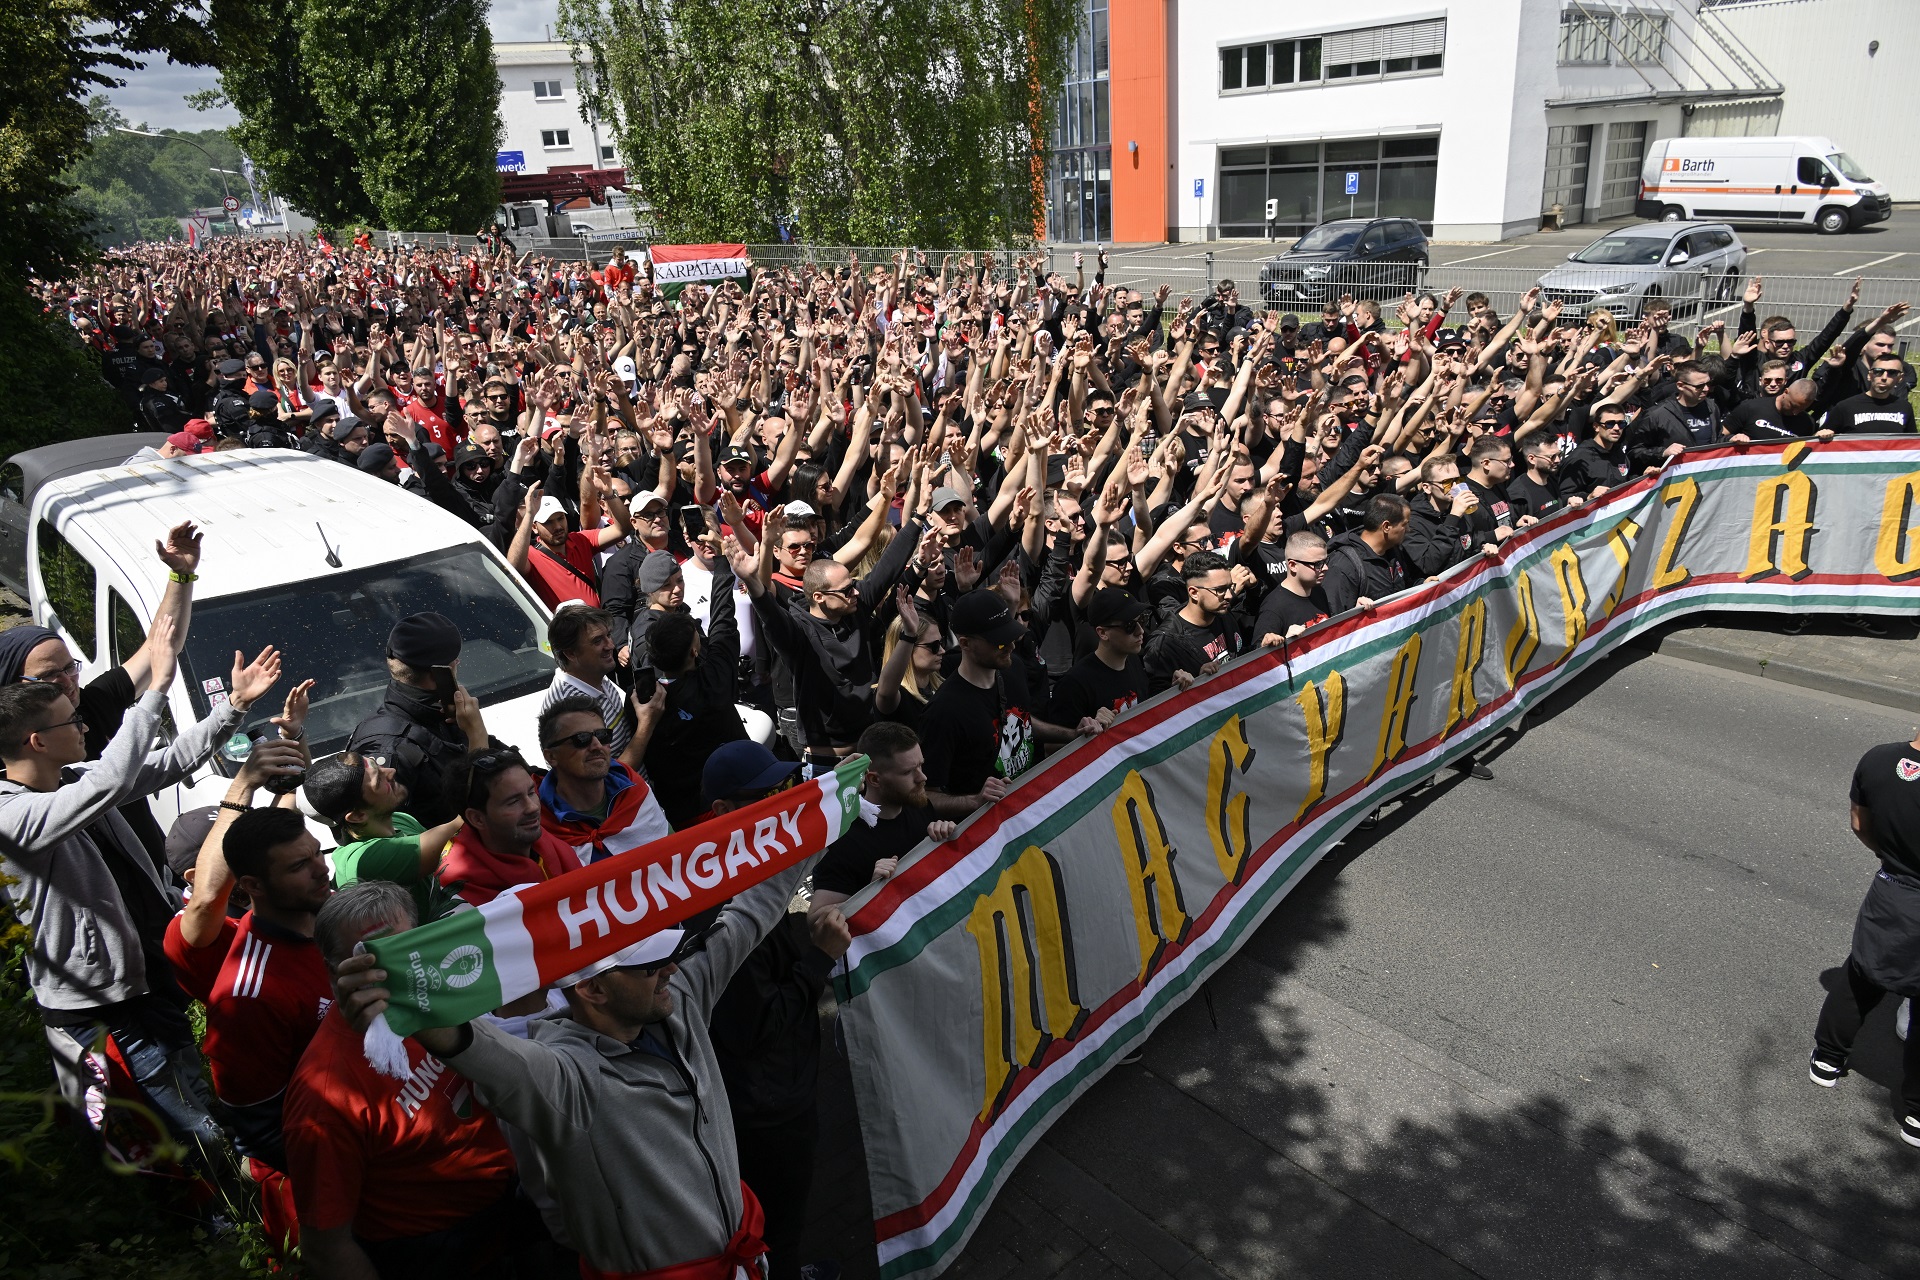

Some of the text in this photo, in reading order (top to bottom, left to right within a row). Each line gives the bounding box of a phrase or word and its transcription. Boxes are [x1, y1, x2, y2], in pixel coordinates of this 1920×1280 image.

[1681, 158, 1715, 172] Barth
[1195, 180, 1202, 190] P
[1348, 174, 1357, 186] P
[654, 259, 748, 280] KÁRPÁTALJA
[433, 424, 441, 439] 5
[557, 802, 806, 950] HUNGARY
[409, 951, 431, 1013] EURO2024
